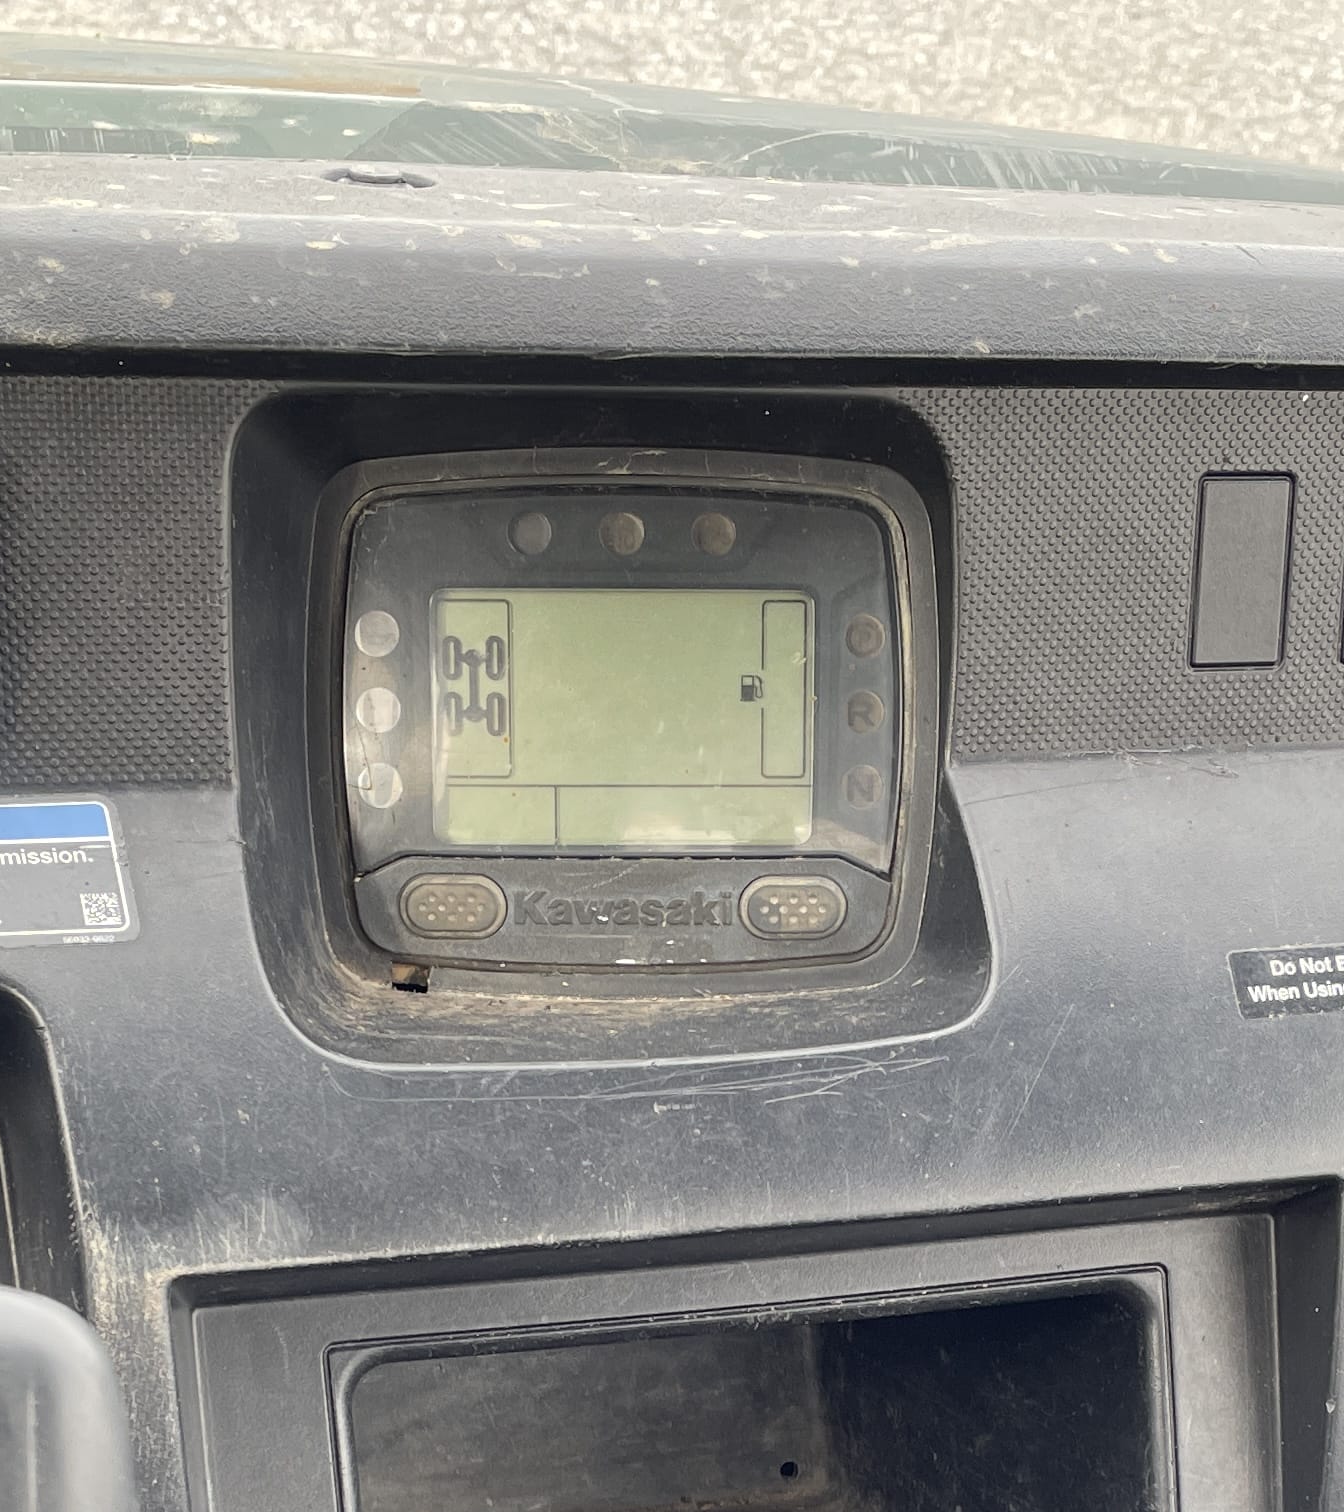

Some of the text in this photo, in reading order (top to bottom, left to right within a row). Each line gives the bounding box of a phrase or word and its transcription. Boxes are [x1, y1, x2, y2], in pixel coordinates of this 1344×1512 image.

[511, 890, 734, 926] Kawasaki
[1269, 958, 1296, 977] Do
[1301, 955, 1333, 974] Not
[1247, 982, 1301, 1003] When
